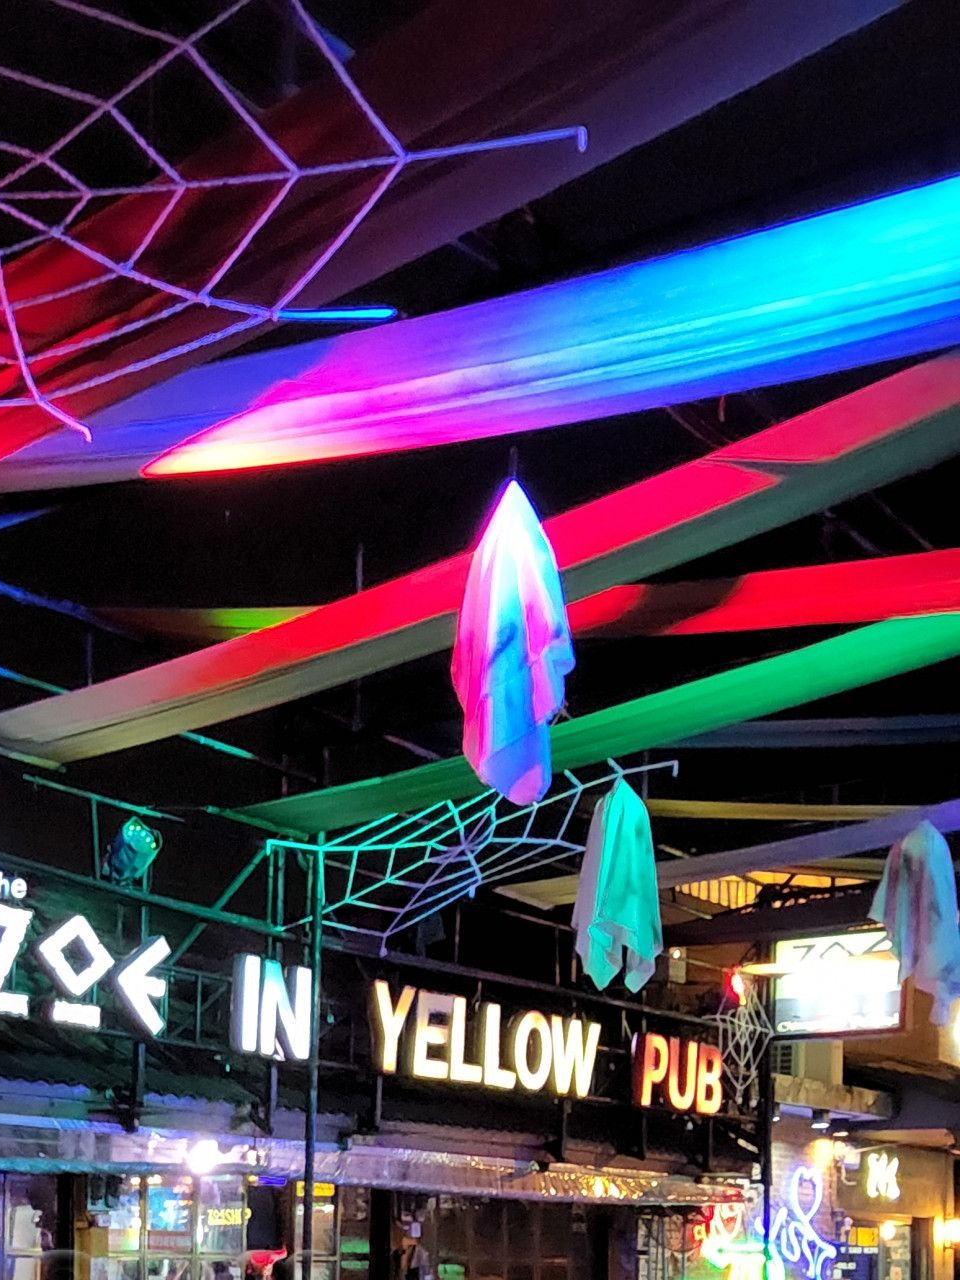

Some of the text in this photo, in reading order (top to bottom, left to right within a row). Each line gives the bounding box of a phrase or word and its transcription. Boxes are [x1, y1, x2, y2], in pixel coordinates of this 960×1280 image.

[235, 953, 312, 1060] IN
[373, 979, 601, 1098] YELLOW
[636, 1031, 723, 1115] PUB
